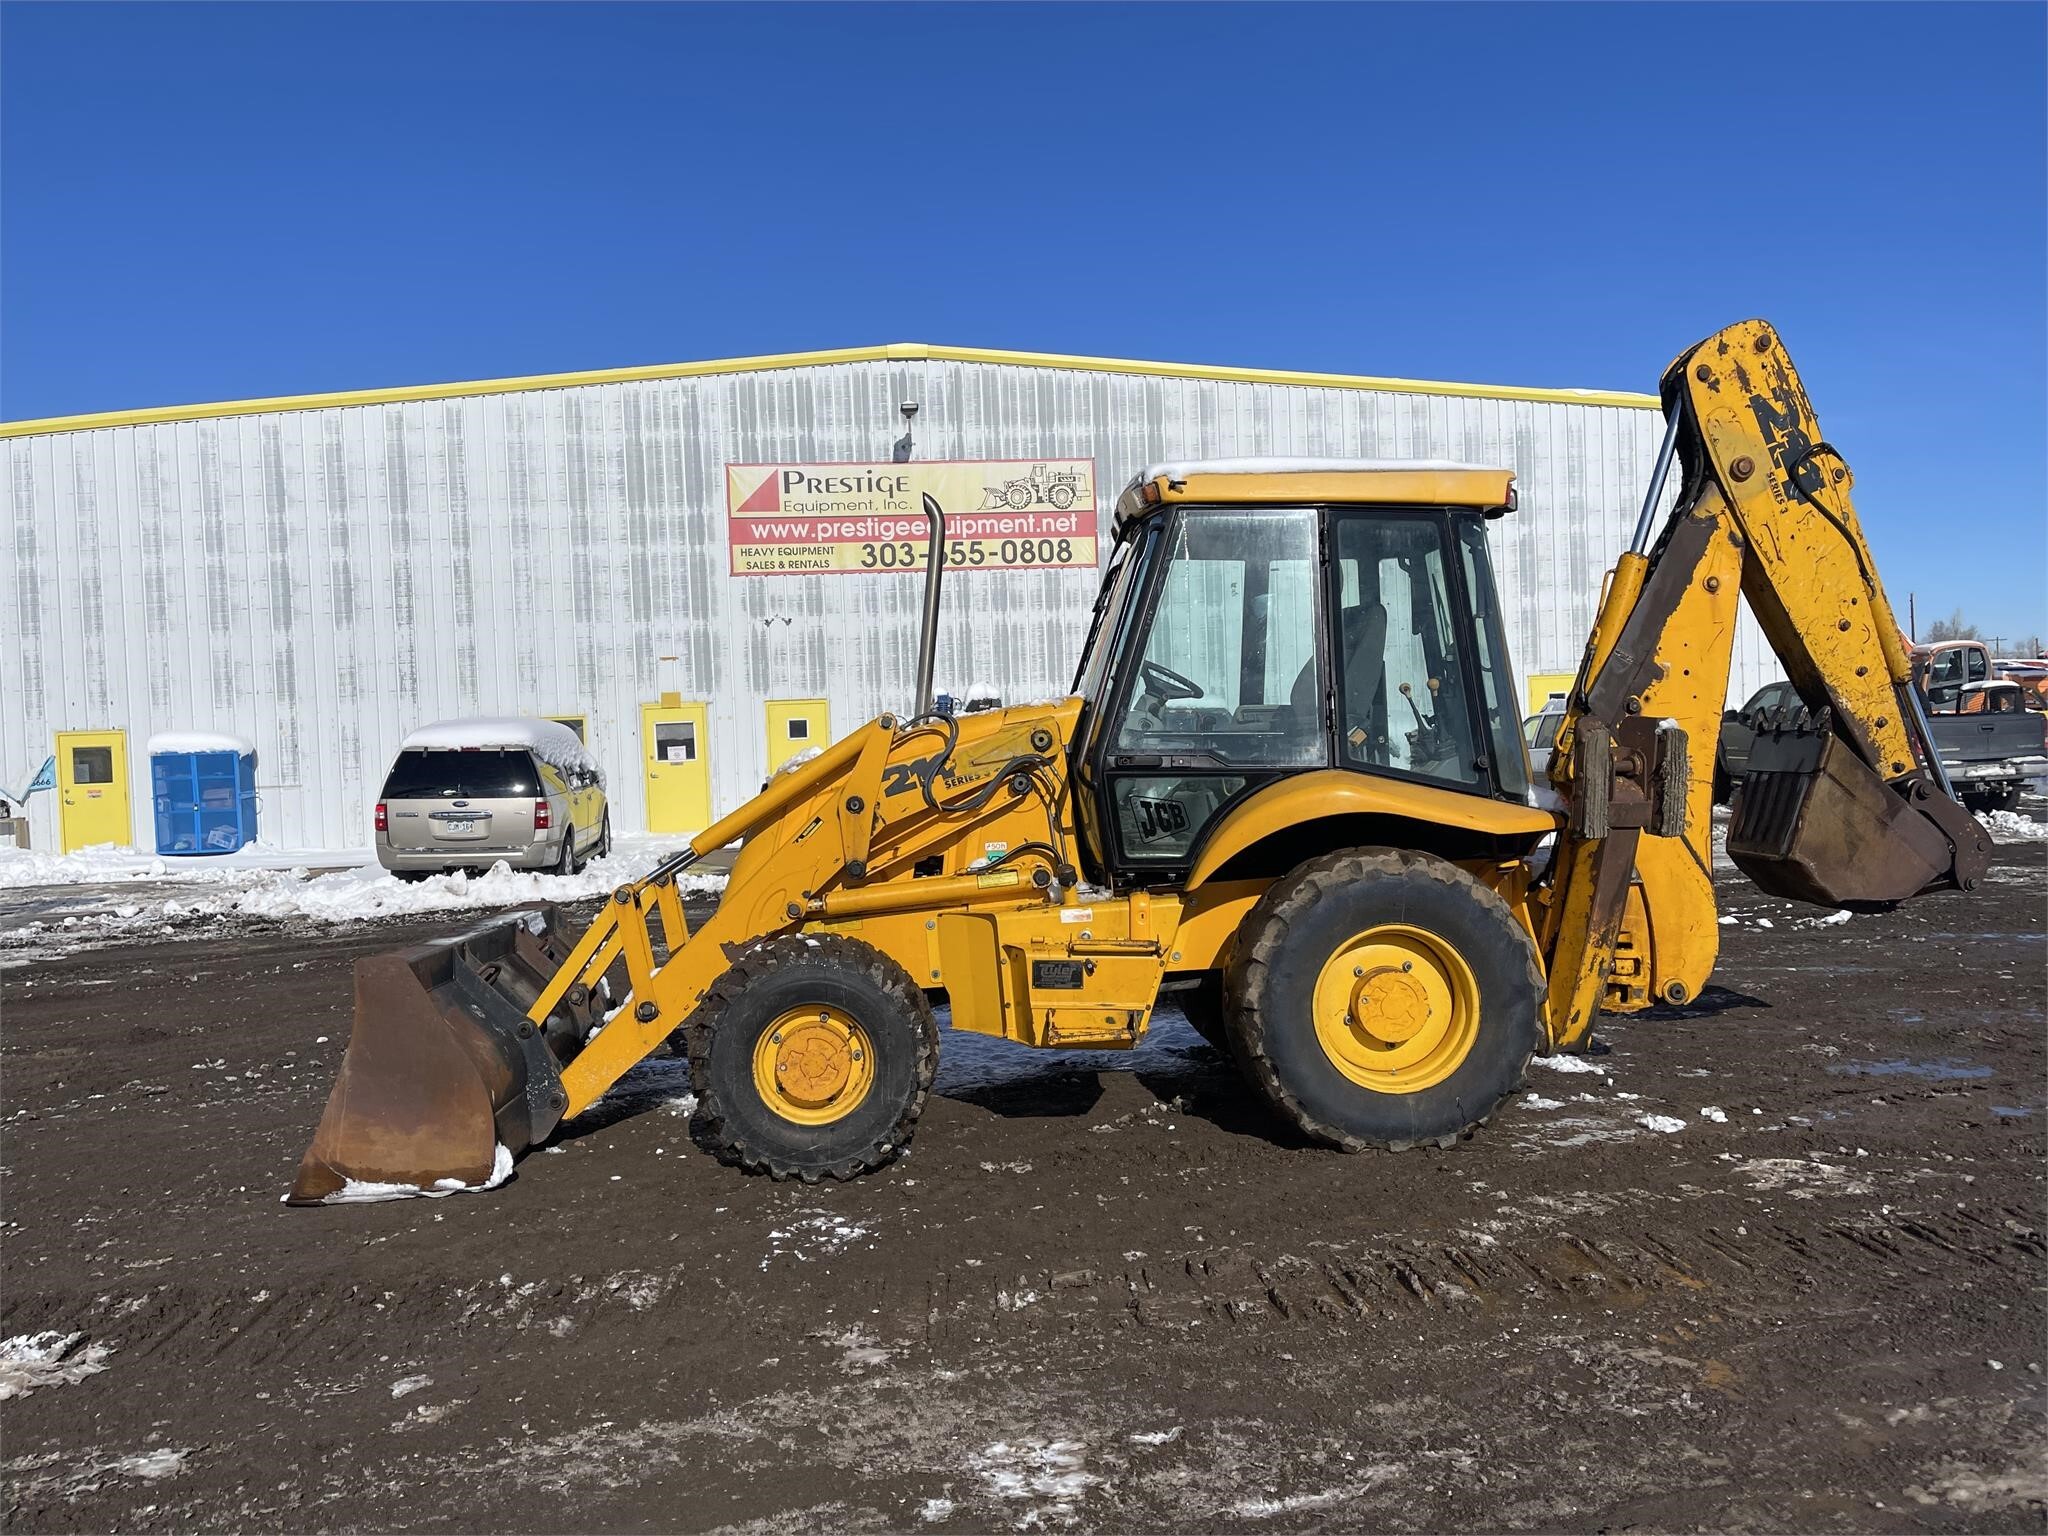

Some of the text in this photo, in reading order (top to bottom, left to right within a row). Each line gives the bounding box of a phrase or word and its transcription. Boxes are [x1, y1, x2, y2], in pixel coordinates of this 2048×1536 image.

[783, 499, 913, 514] Equipment, Inc.
[1768, 471, 1789, 515] SERIES 3
[751, 513, 1078, 542] www.prestigeeuipment.net
[740, 546, 835, 557] HEAVY EQUIPMENT
[746, 559, 830, 570] SALES & RENTALS
[860, 539, 1073, 568] 303-55-0808
[1139, 800, 1186, 839] JCB
